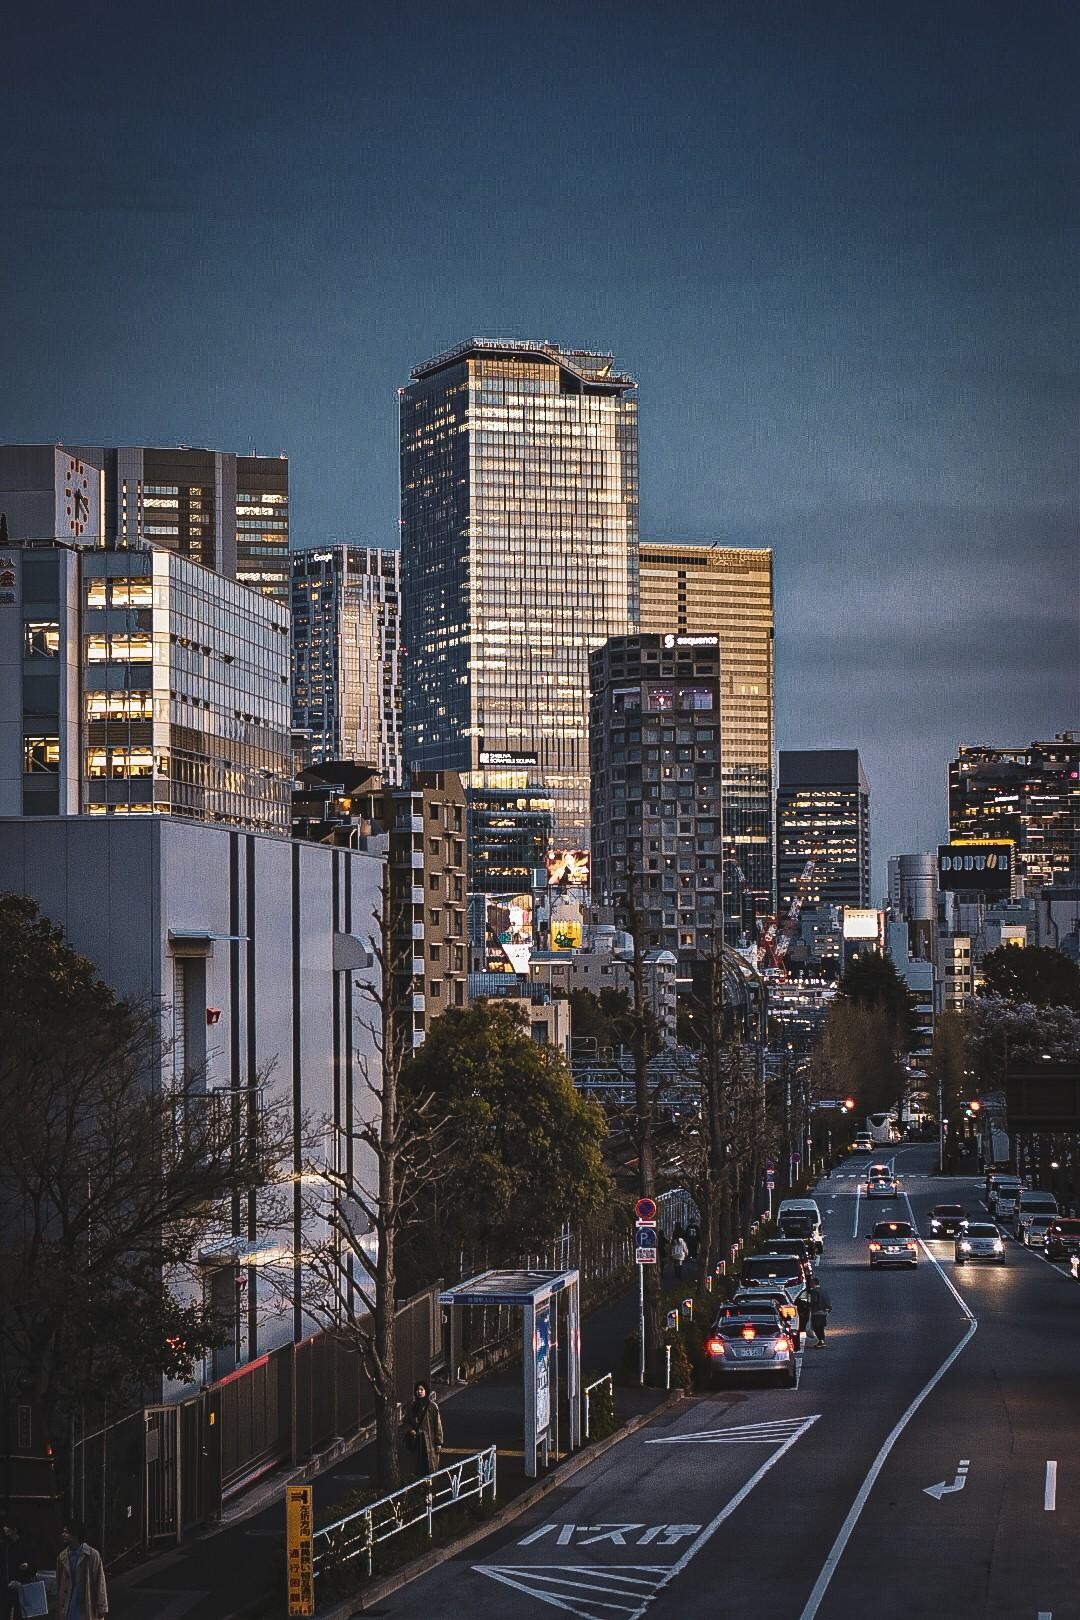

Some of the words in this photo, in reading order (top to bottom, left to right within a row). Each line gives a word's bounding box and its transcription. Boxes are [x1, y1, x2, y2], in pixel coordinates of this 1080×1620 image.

[314, 553, 333, 562] Google
[677, 636, 718, 646] sequence
[517, 1524, 702, 1545] バス停
